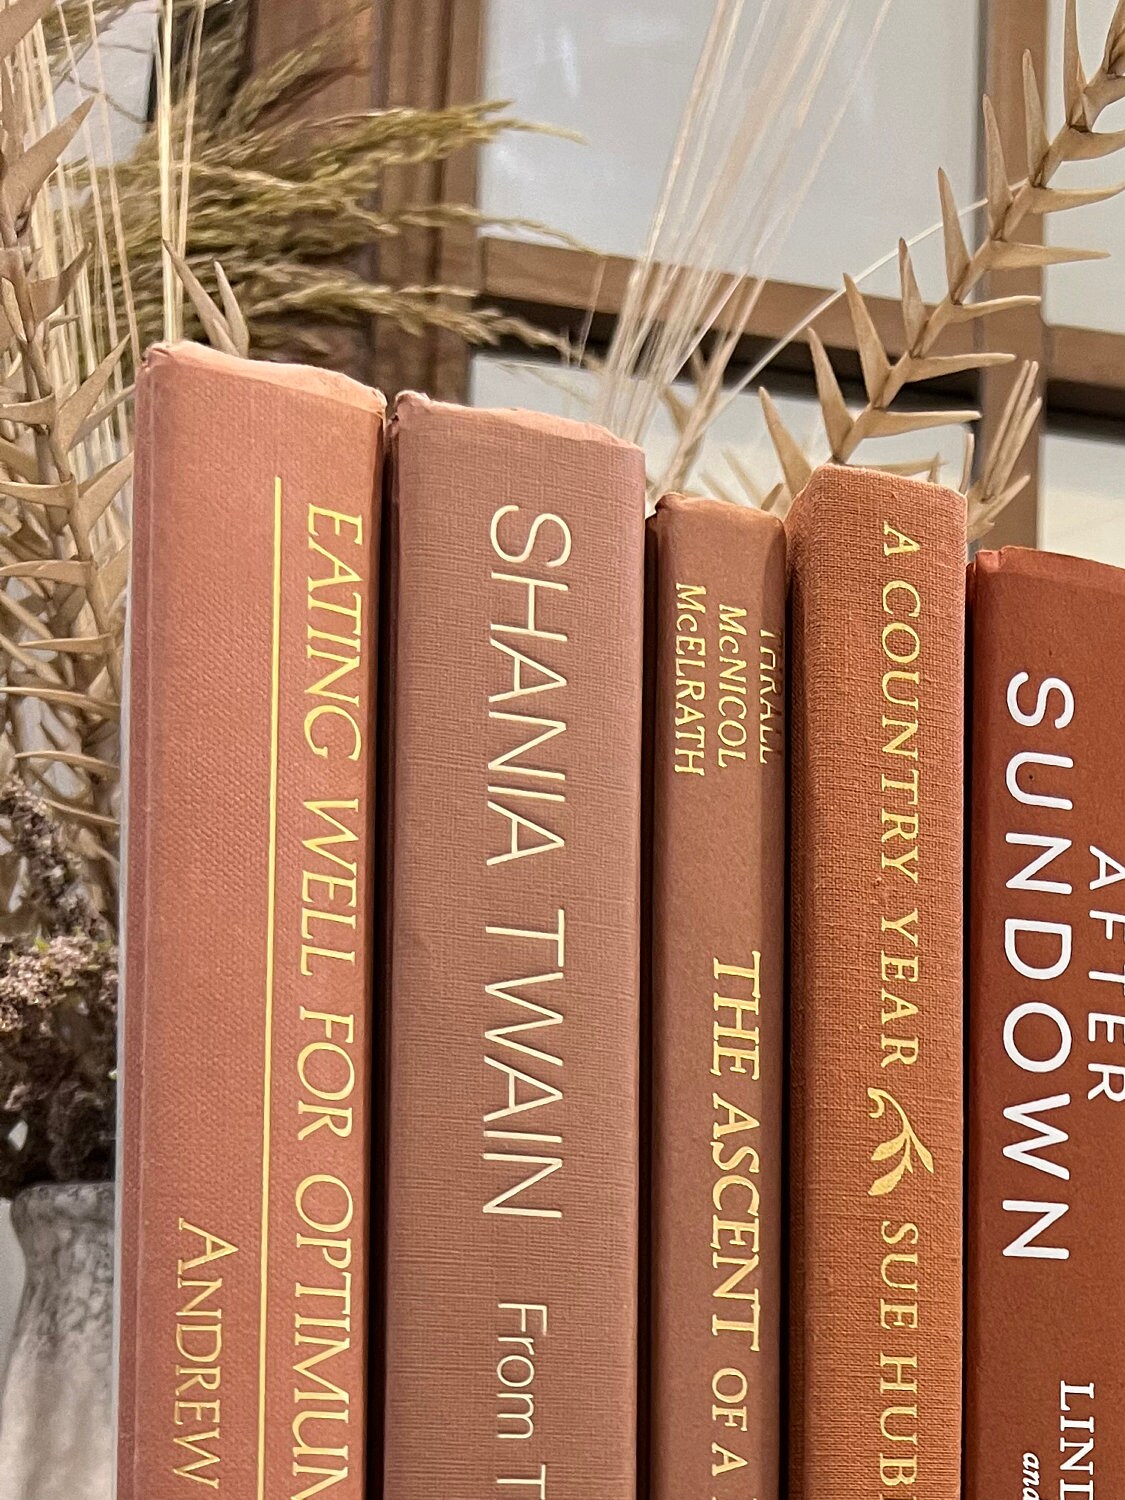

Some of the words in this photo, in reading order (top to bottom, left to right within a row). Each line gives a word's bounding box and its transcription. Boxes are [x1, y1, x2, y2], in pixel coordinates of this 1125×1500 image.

[883, 521, 921, 557] A
[303, 503, 363, 760] EATING
[485, 504, 573, 866] SHANIA
[674, 582, 708, 777] McELRATH
[718, 603, 748, 769] McNICOL
[881, 580, 921, 884] COUNTRY
[299, 798, 360, 977] WELL
[1001, 670, 1075, 1261] SUNDOWN
[482, 909, 566, 1219] TWAIN
[710, 950, 761, 1081] THE
[880, 910, 920, 1068] YEAR
[295, 1005, 355, 1142] FOR
[710, 1093, 761, 1352] ASCENT
[879, 1220, 920, 1330] SUE
[495, 1301, 549, 1440] From
[711, 1367, 749, 1432] OF
[710, 1441, 747, 1478] A
